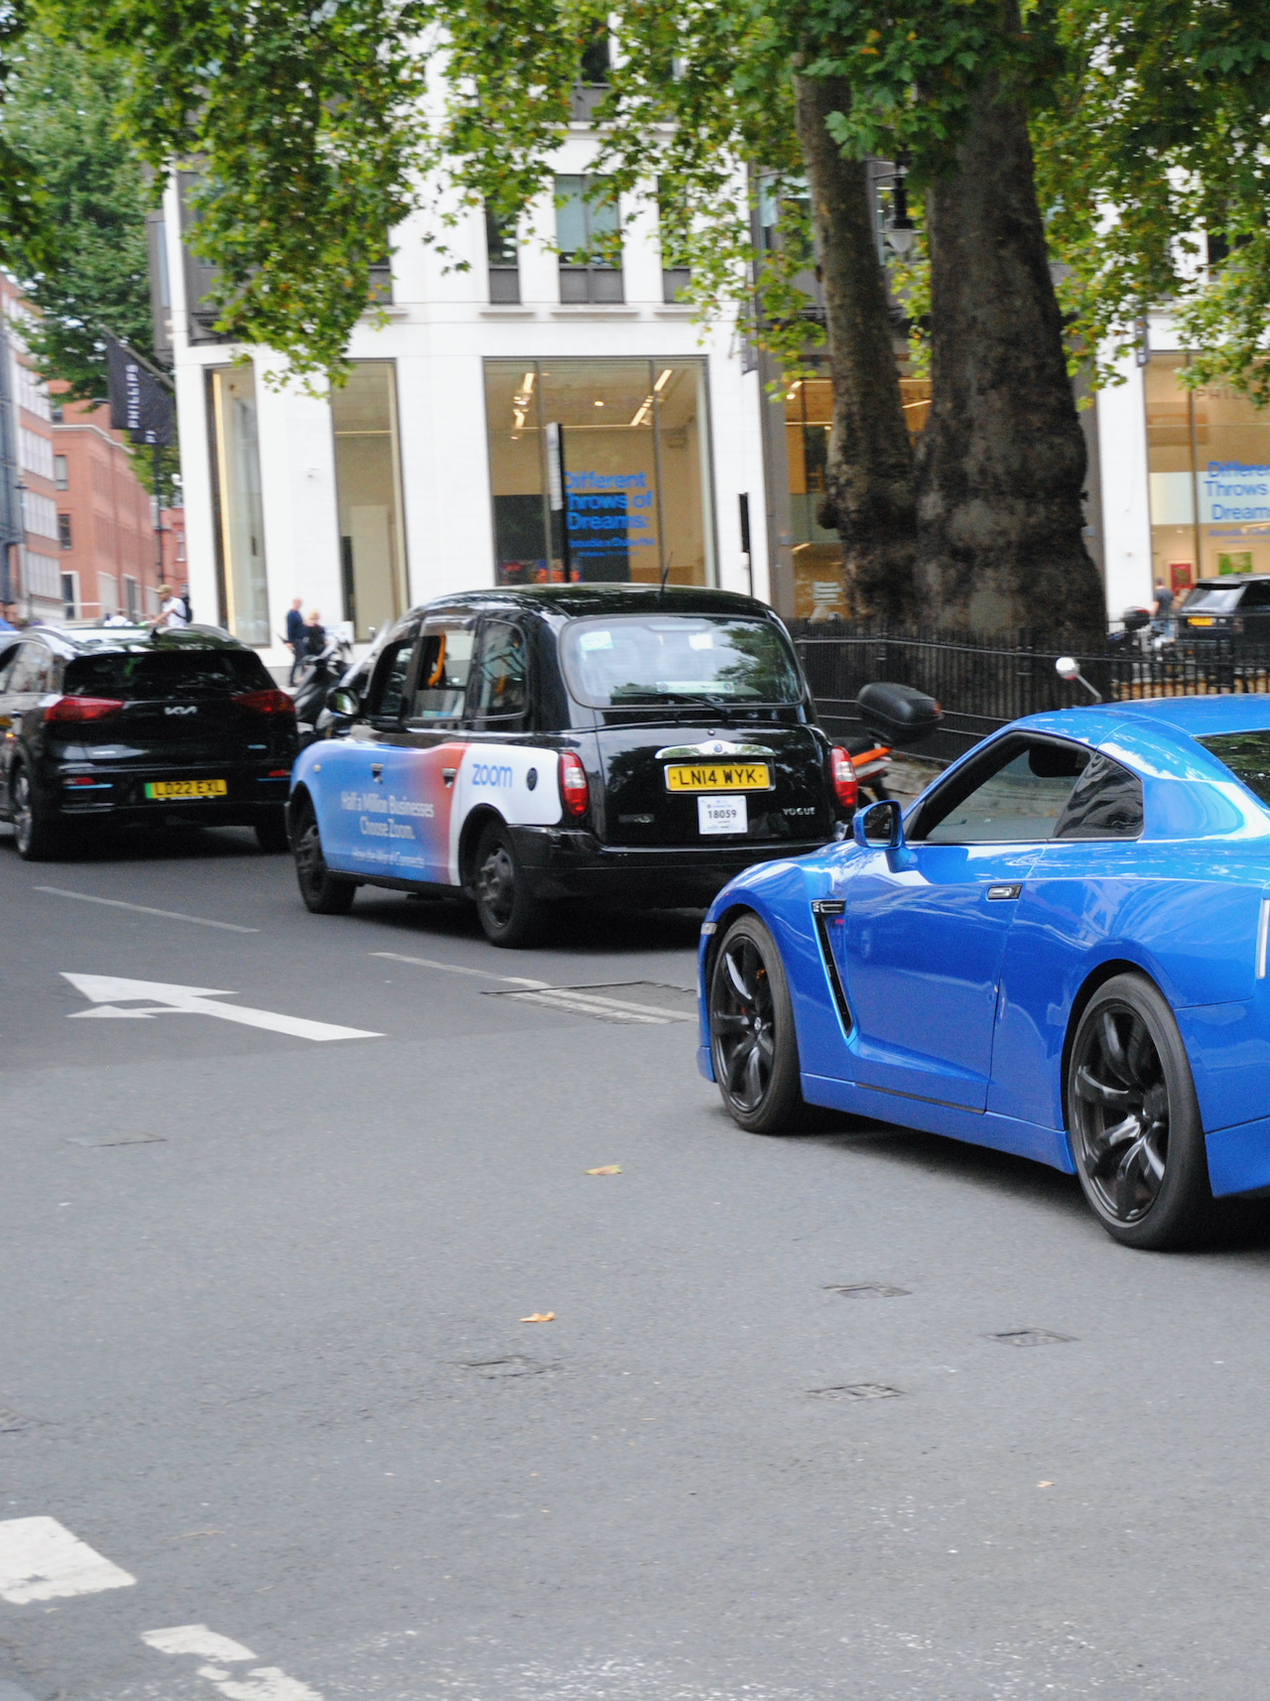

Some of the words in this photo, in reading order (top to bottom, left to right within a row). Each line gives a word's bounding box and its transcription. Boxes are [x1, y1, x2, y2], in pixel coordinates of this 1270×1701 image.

[125, 364, 140, 429] PHILLIPS
[1204, 480, 1268, 497] Throws
[472, 763, 513, 788] zoom
[679, 769, 718, 786] LN14
[723, 768, 758, 785] WYK
[197, 780, 224, 795] EXL
[389, 795, 435, 819] Businesses
[708, 809, 737, 820] 18059
[782, 807, 816, 816] VOGUE
[360, 816, 388, 838] Choose
